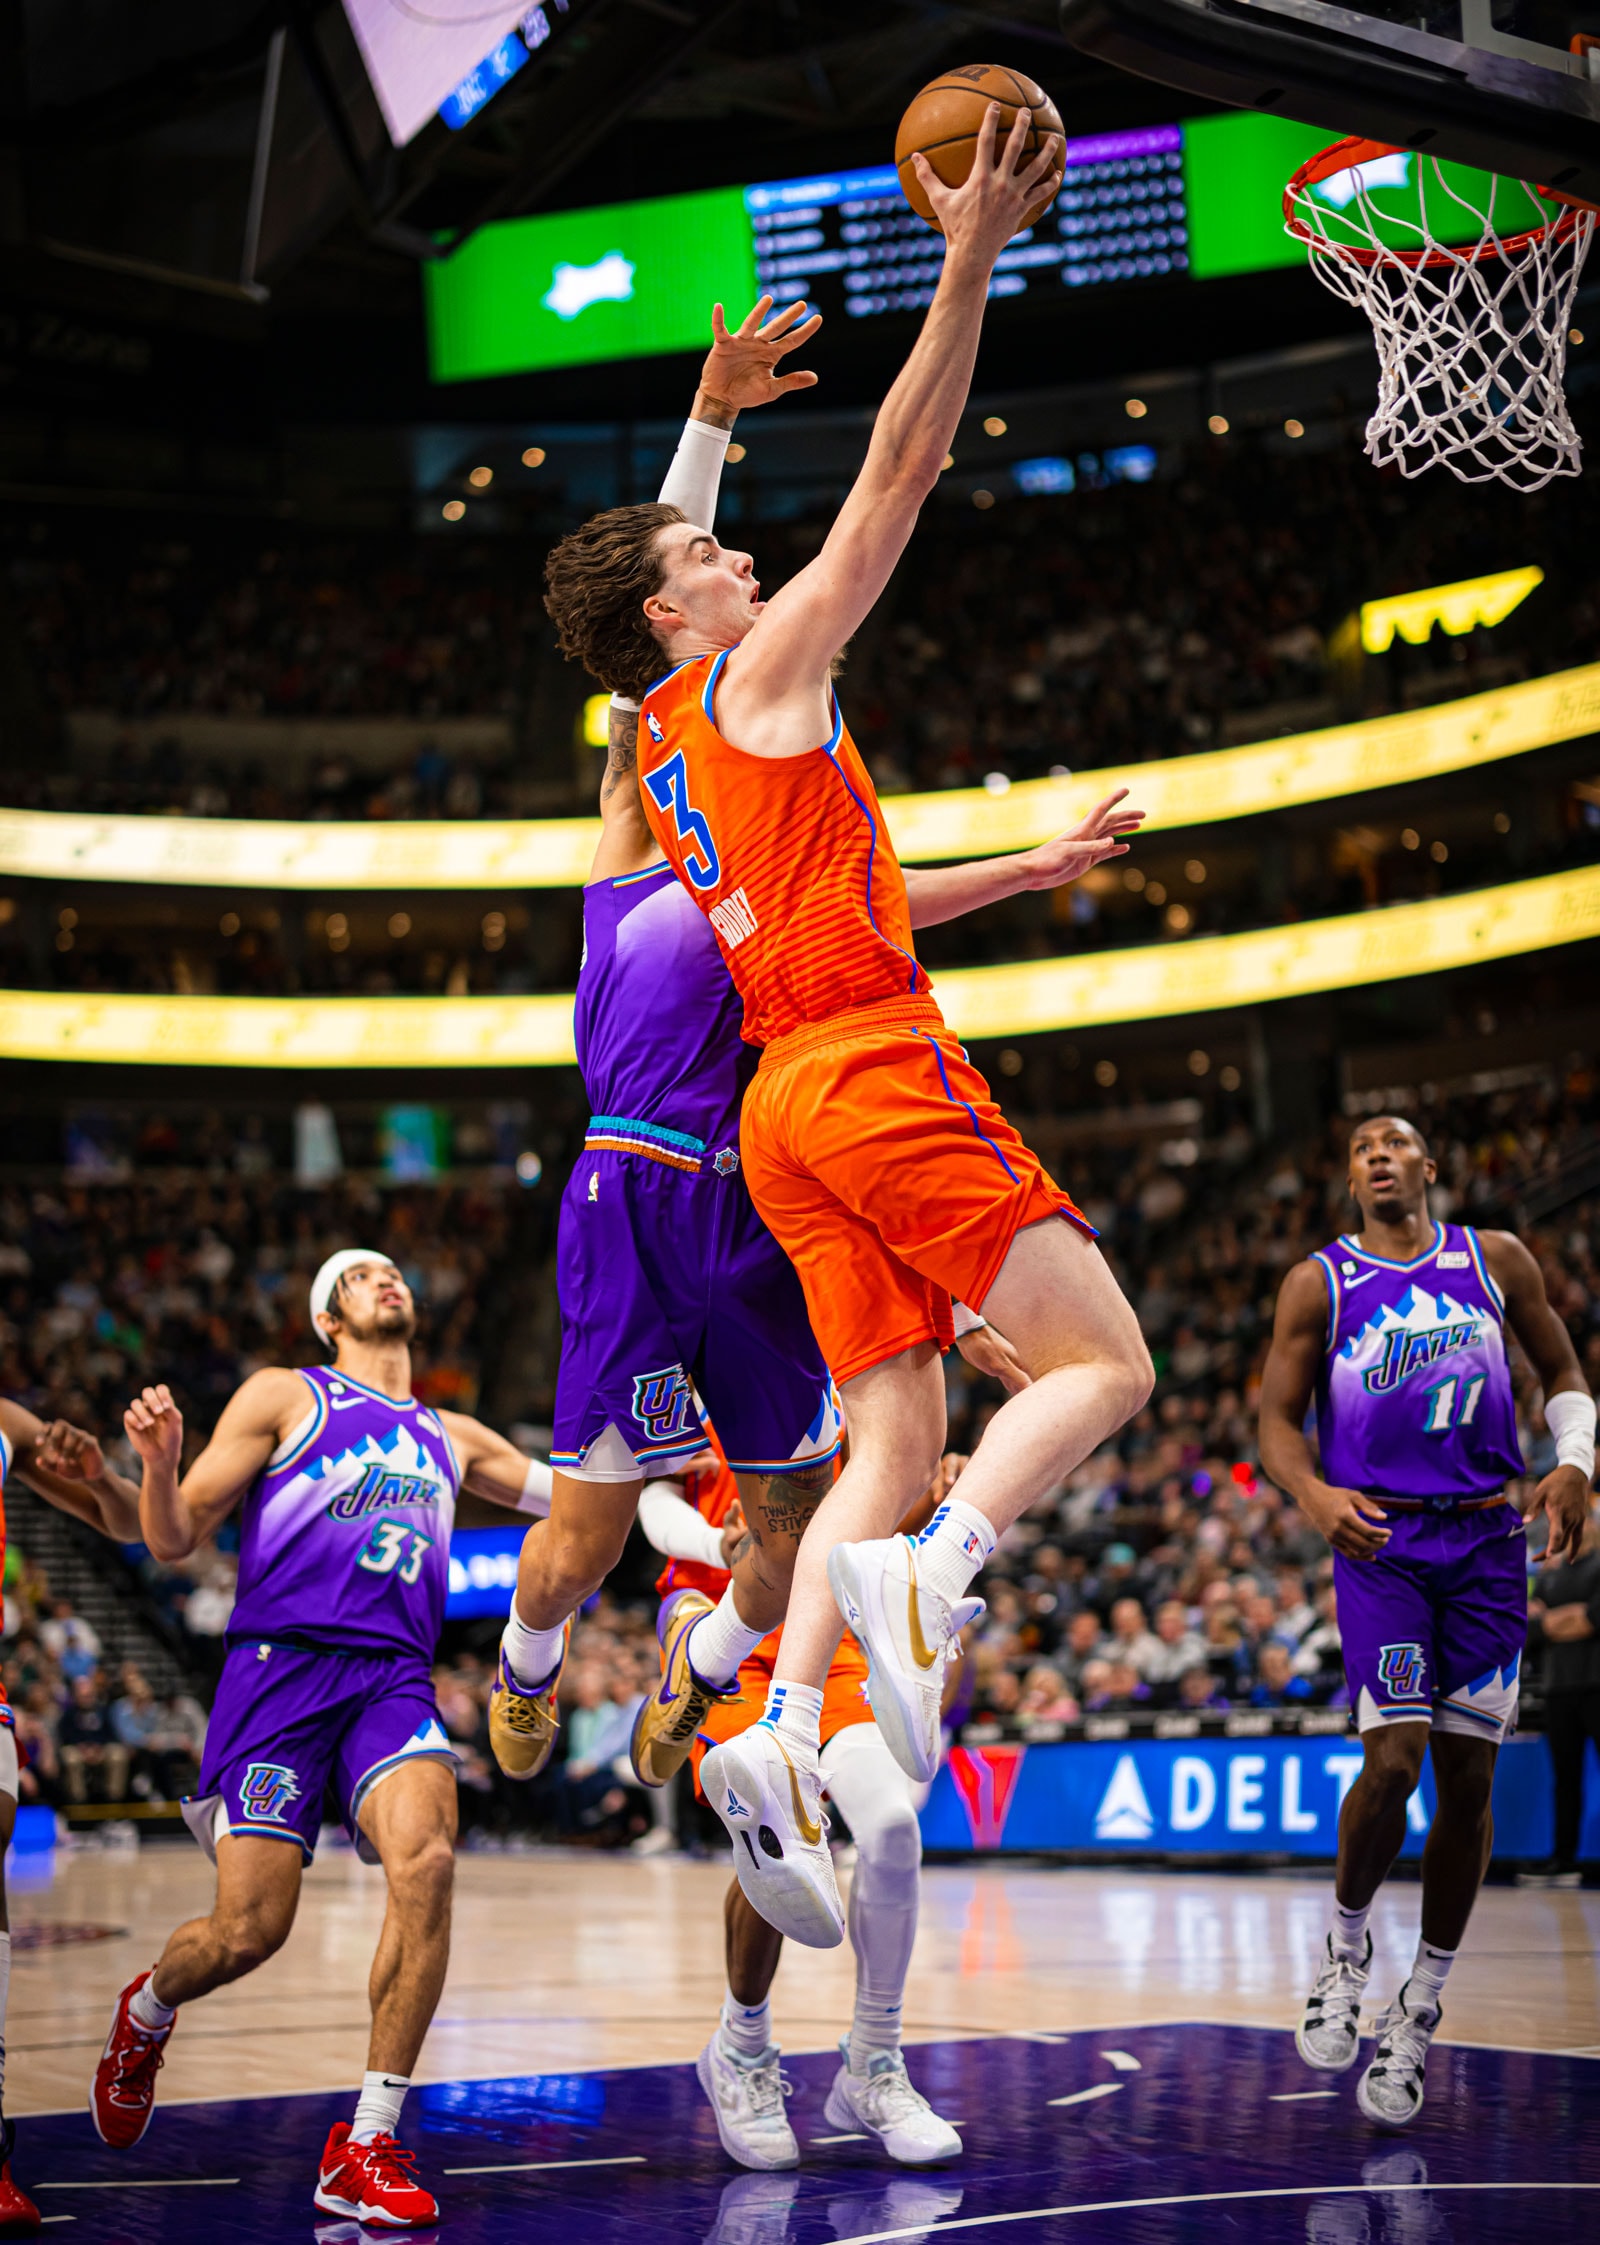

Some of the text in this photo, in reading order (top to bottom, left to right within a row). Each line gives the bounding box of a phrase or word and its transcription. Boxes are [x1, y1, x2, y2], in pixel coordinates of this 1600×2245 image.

[643, 749, 720, 890] 3
[1423, 1373, 1487, 1433] 11
[357, 1518, 433, 1586] 33
